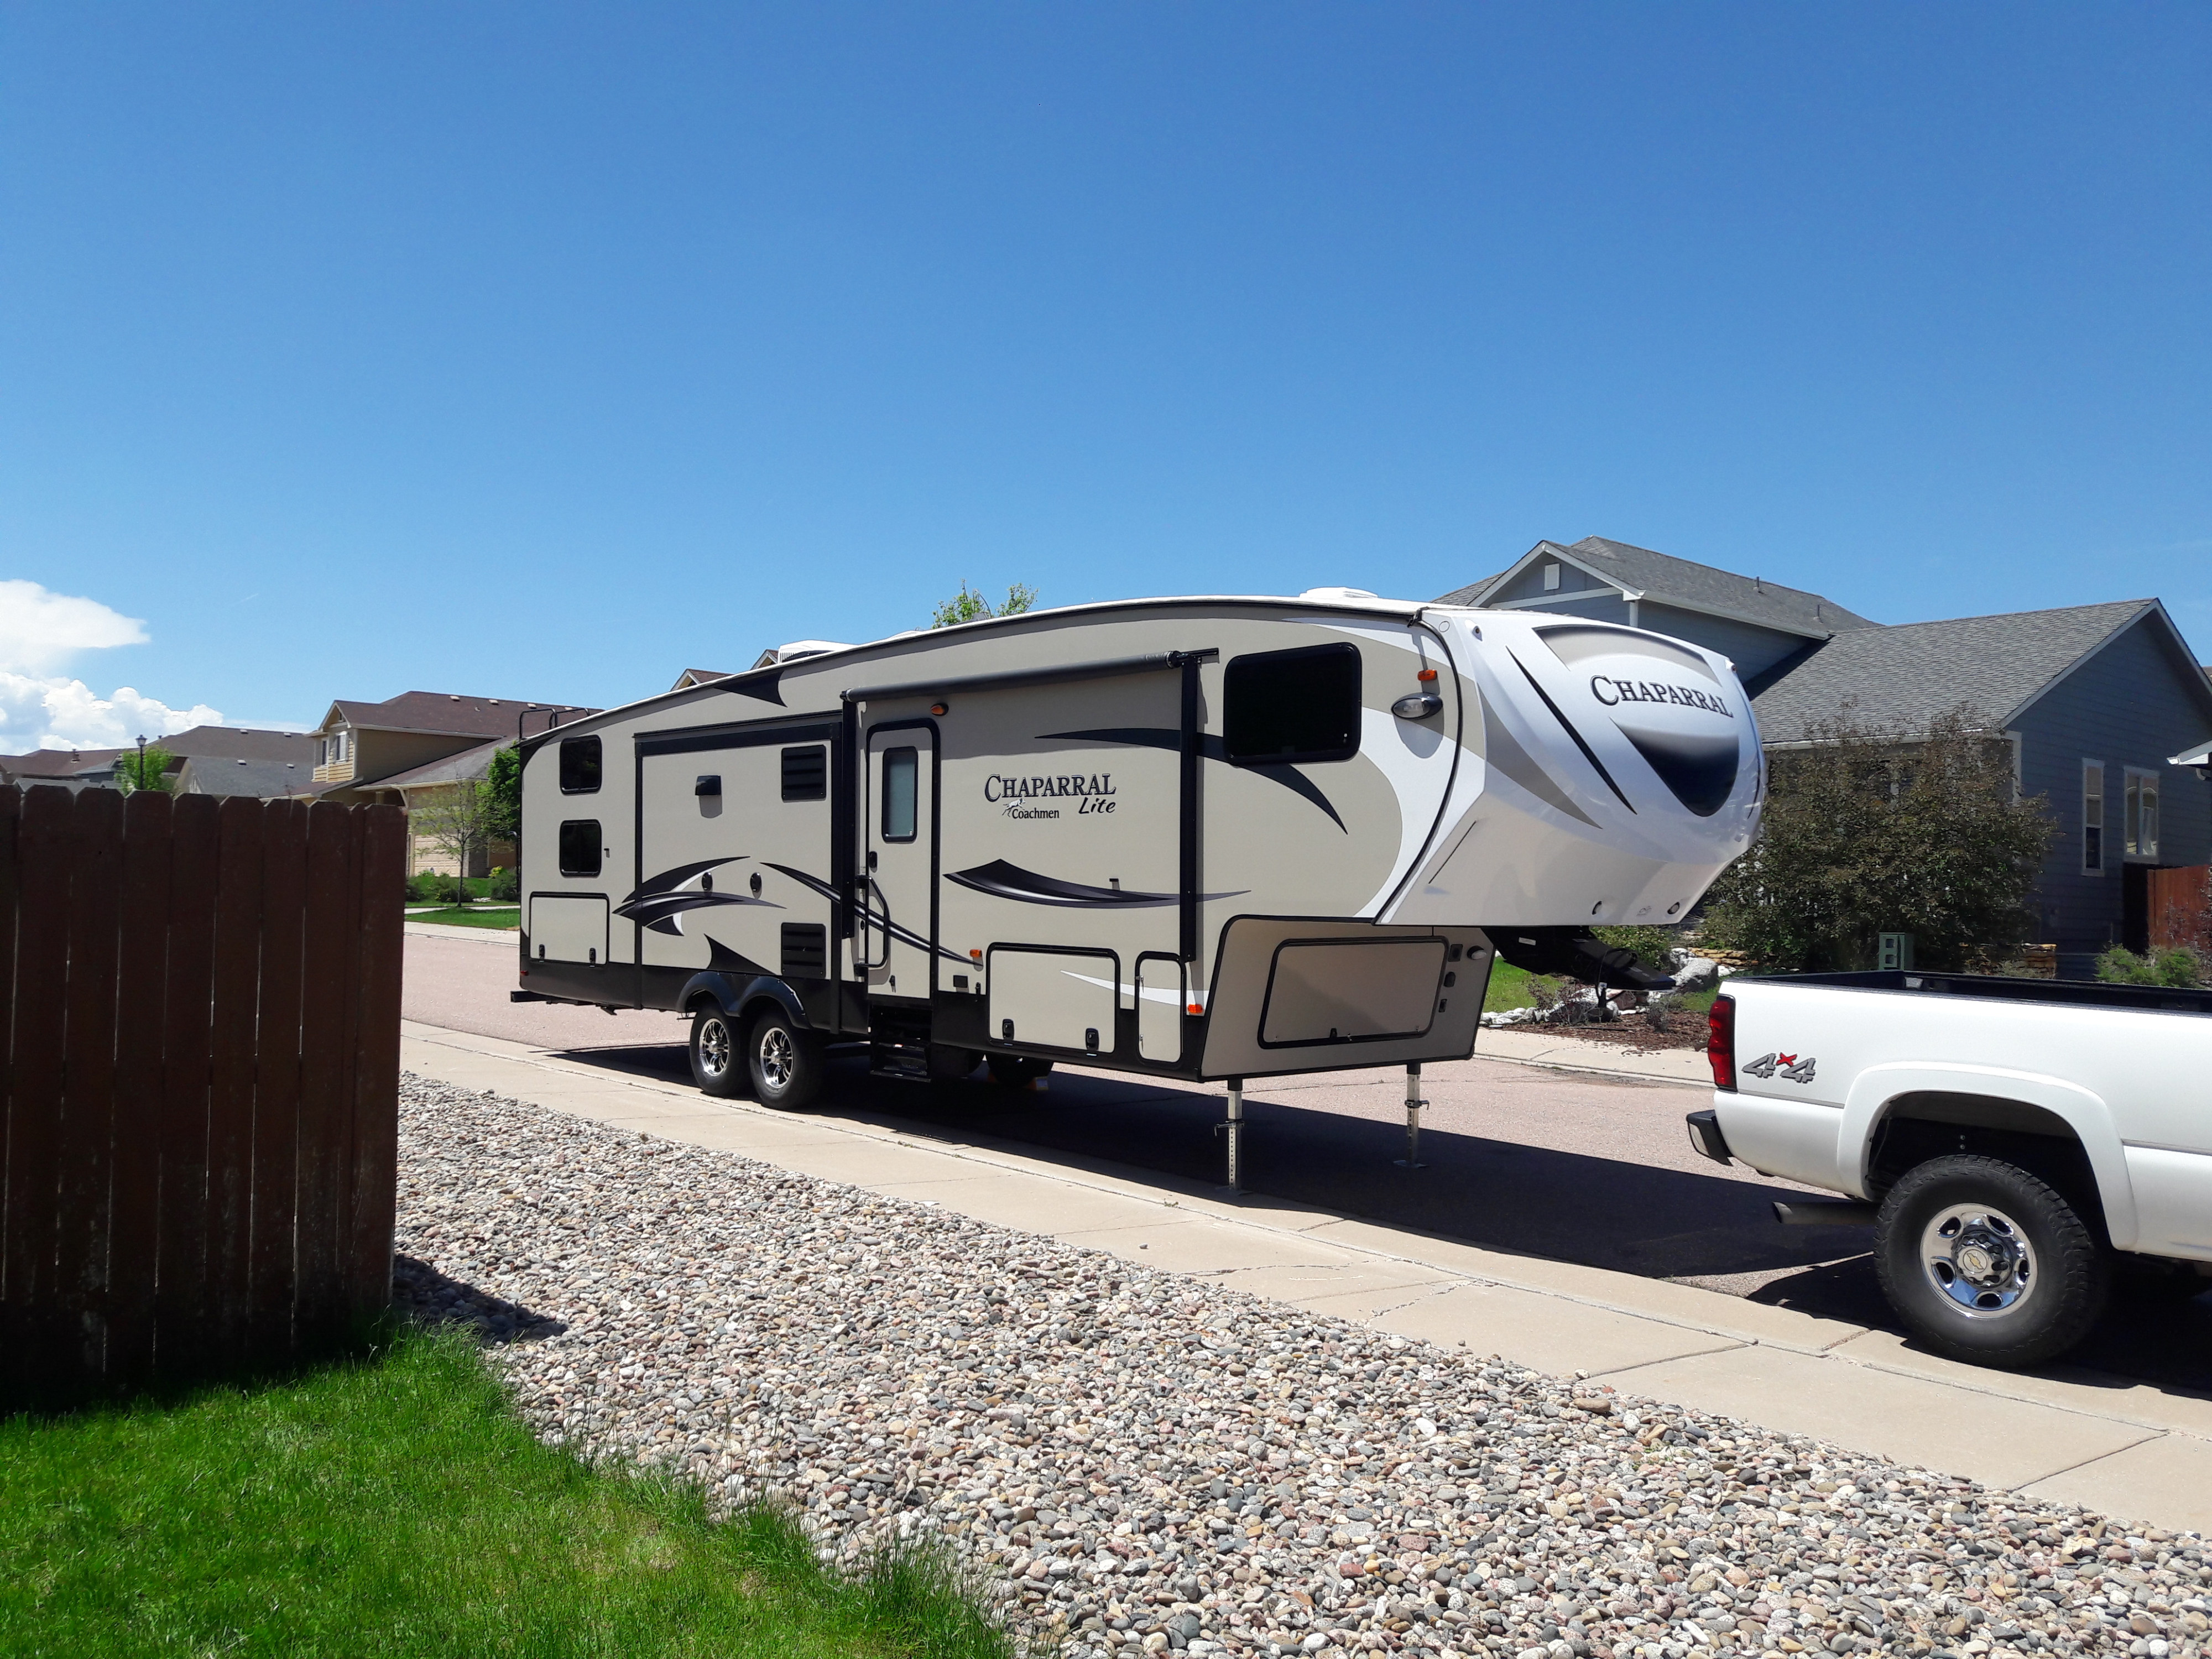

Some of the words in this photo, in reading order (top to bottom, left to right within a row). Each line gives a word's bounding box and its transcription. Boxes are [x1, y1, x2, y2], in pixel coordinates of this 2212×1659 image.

[1590, 675, 1734, 718] CHAPARRAL
[984, 774, 1117, 802] CHAPARRAL
[1011, 807, 1060, 819] Coachmen
[1078, 797, 1116, 814] Lite
